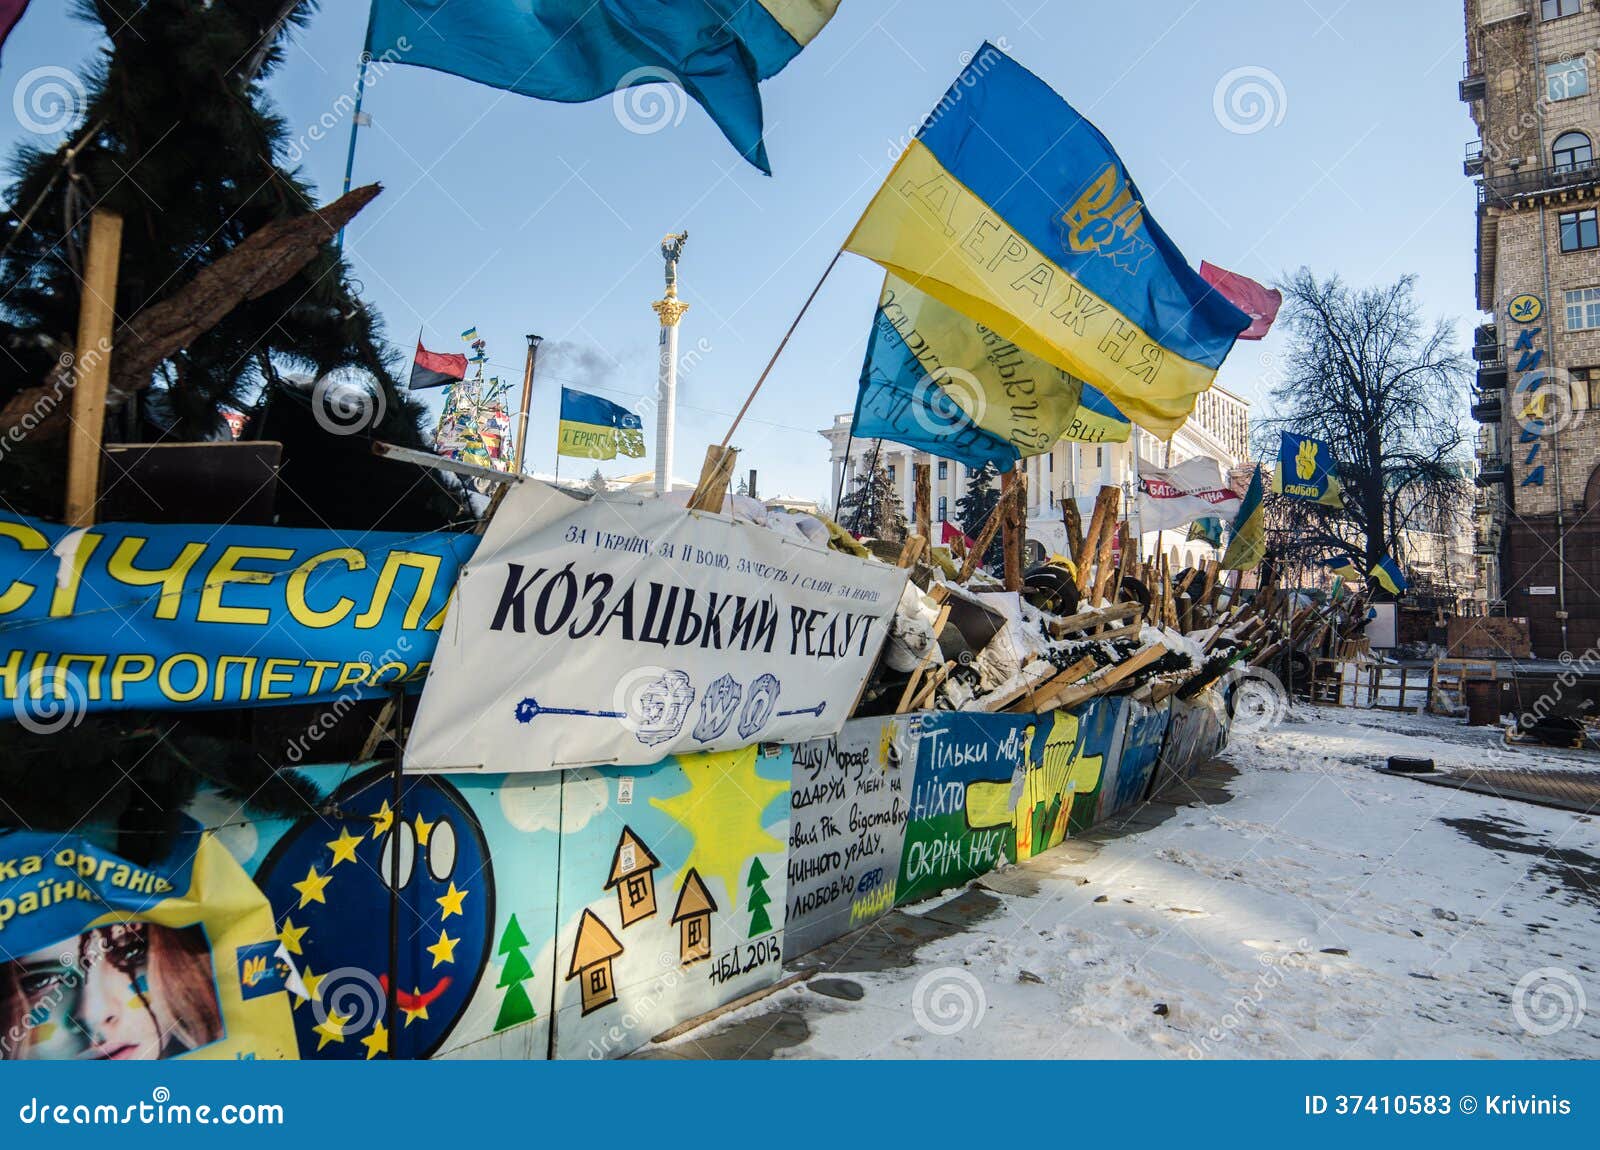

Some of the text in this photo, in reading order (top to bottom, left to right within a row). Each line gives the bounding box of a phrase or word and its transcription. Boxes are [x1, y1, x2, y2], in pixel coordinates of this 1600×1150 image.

[900, 173, 1164, 385] ДЕРАЖНЯ
[565, 525, 587, 545] ЗА
[658, 542, 675, 559] ЗА
[0, 519, 457, 632] СІЧЕСЛ
[489, 561, 880, 661] КОЗАЦЬКИЙ РЕДУТ
[791, 742, 823, 781] Діду
[924, 728, 988, 771] Тільки
[791, 775, 846, 809] ОДАРУЙ
[789, 821, 818, 848] овий
[849, 797, 910, 839] відставку
[54, 848, 175, 894] органів
[906, 832, 961, 882] ОКРІМ
